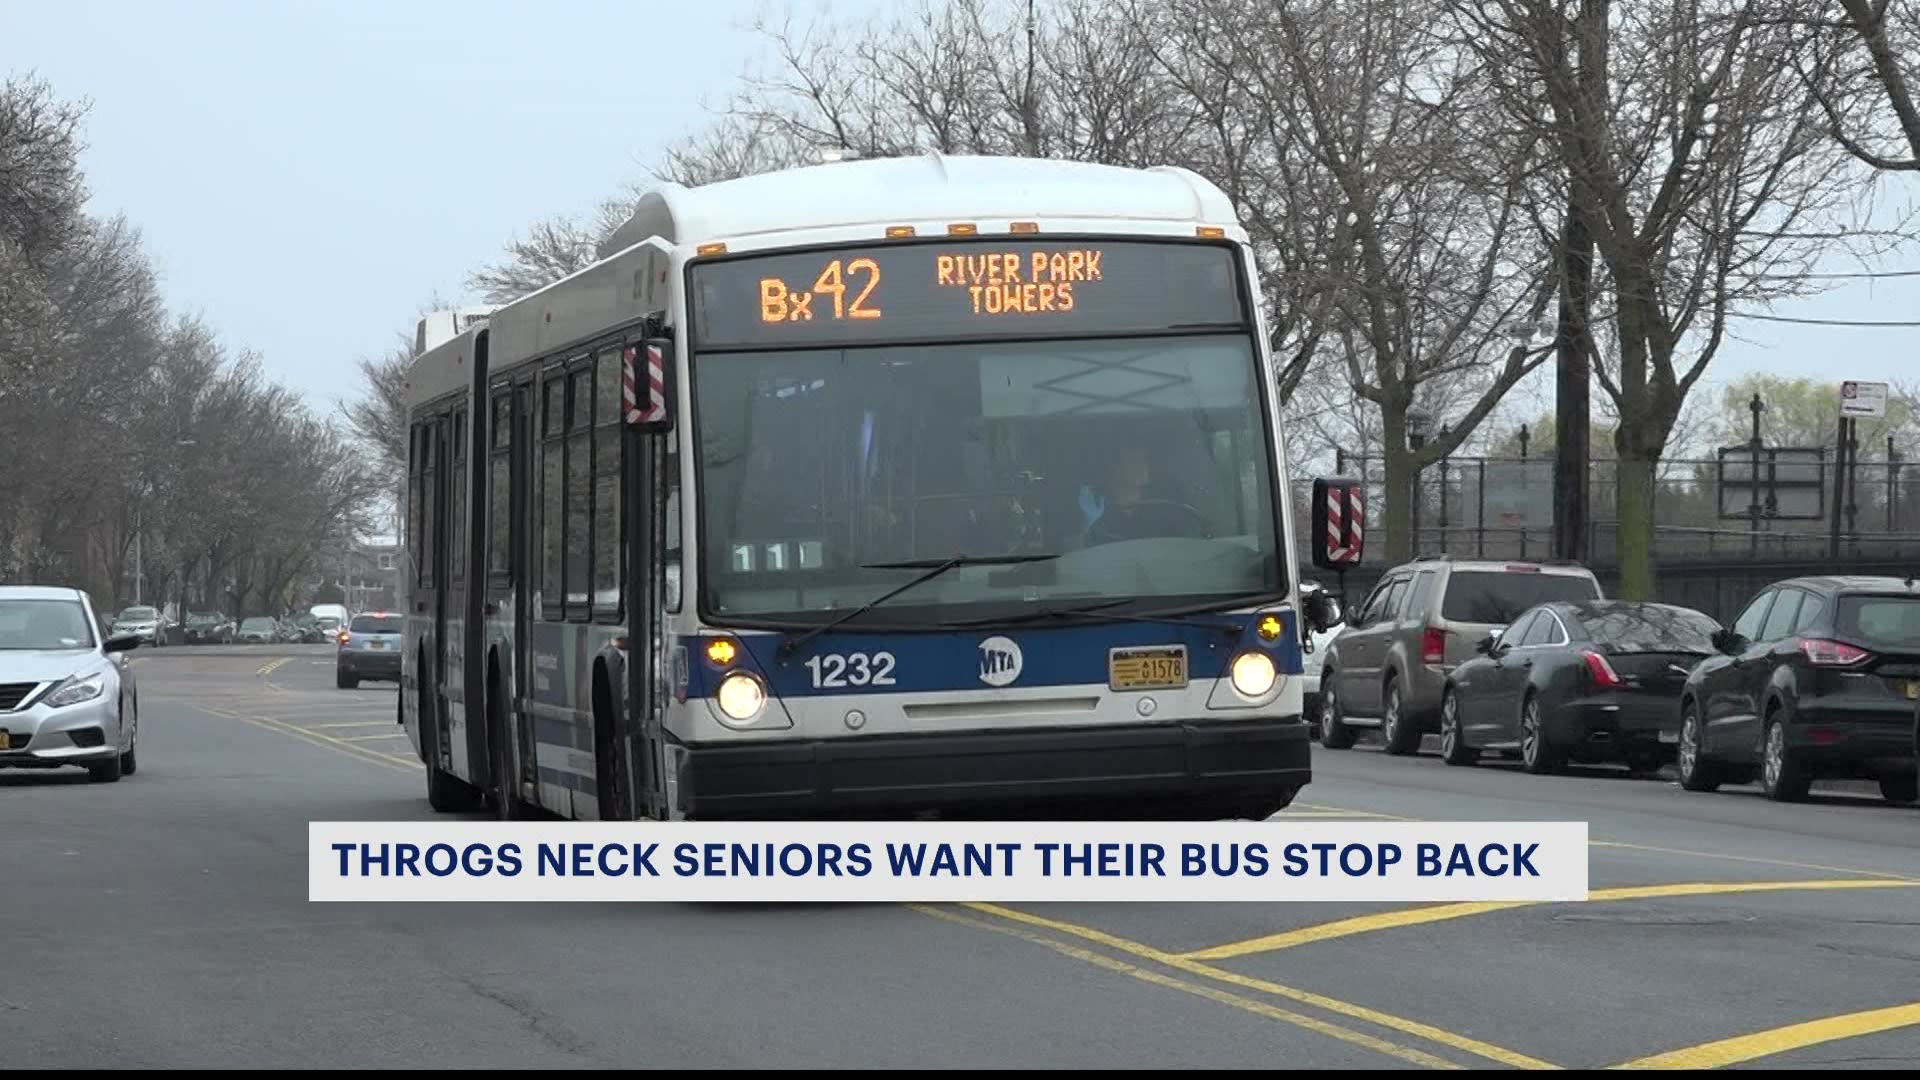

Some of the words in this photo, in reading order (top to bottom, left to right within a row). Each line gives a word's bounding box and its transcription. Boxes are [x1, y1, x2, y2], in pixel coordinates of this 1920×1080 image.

[937, 252, 1020, 285] RIVER
[1031, 250, 1101, 283] PARK
[760, 258, 881, 321] Bx42
[969, 282, 1073, 314] TOWERS
[804, 651, 897, 688] 1232
[1152, 659, 1182, 679] 1578
